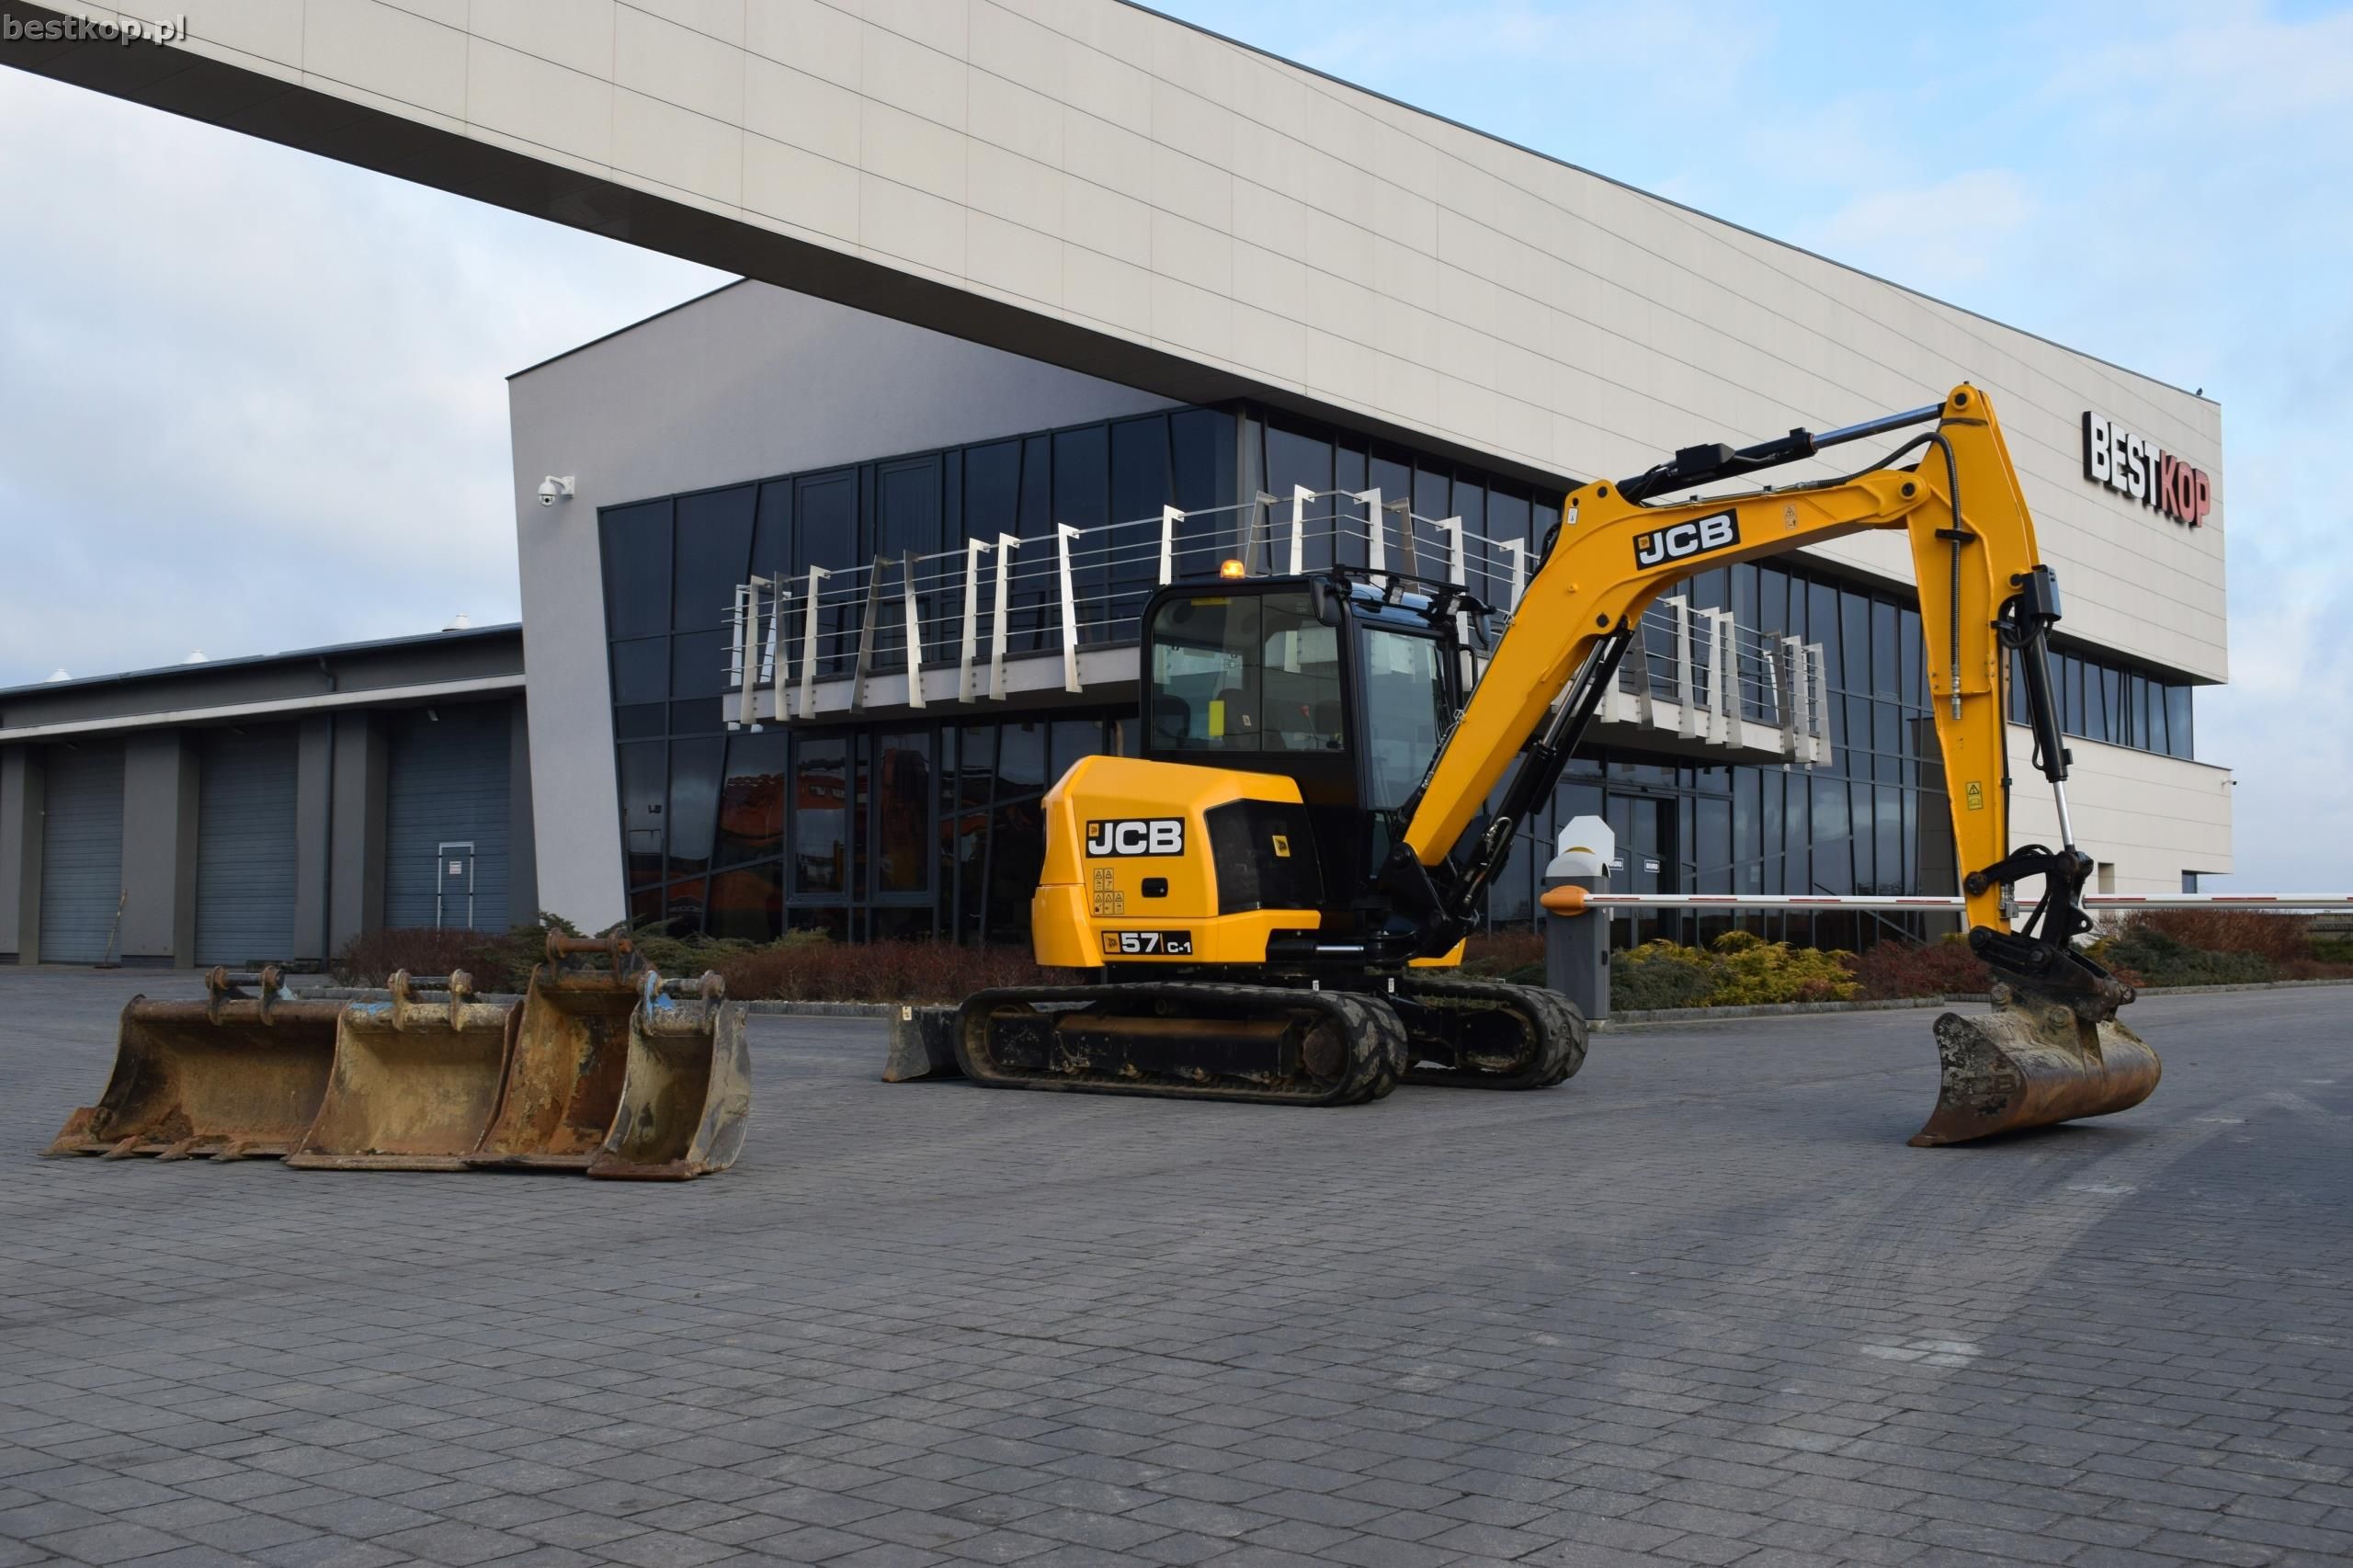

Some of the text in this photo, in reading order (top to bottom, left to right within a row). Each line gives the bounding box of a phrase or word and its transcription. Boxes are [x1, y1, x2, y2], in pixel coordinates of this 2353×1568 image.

[2084, 411, 2211, 528] BESTKOP
[1639, 515, 1733, 565] JCB
[1088, 821, 1183, 855] JCB
[1120, 932, 1159, 953] 57
[1166, 941, 1192, 953] C-1
